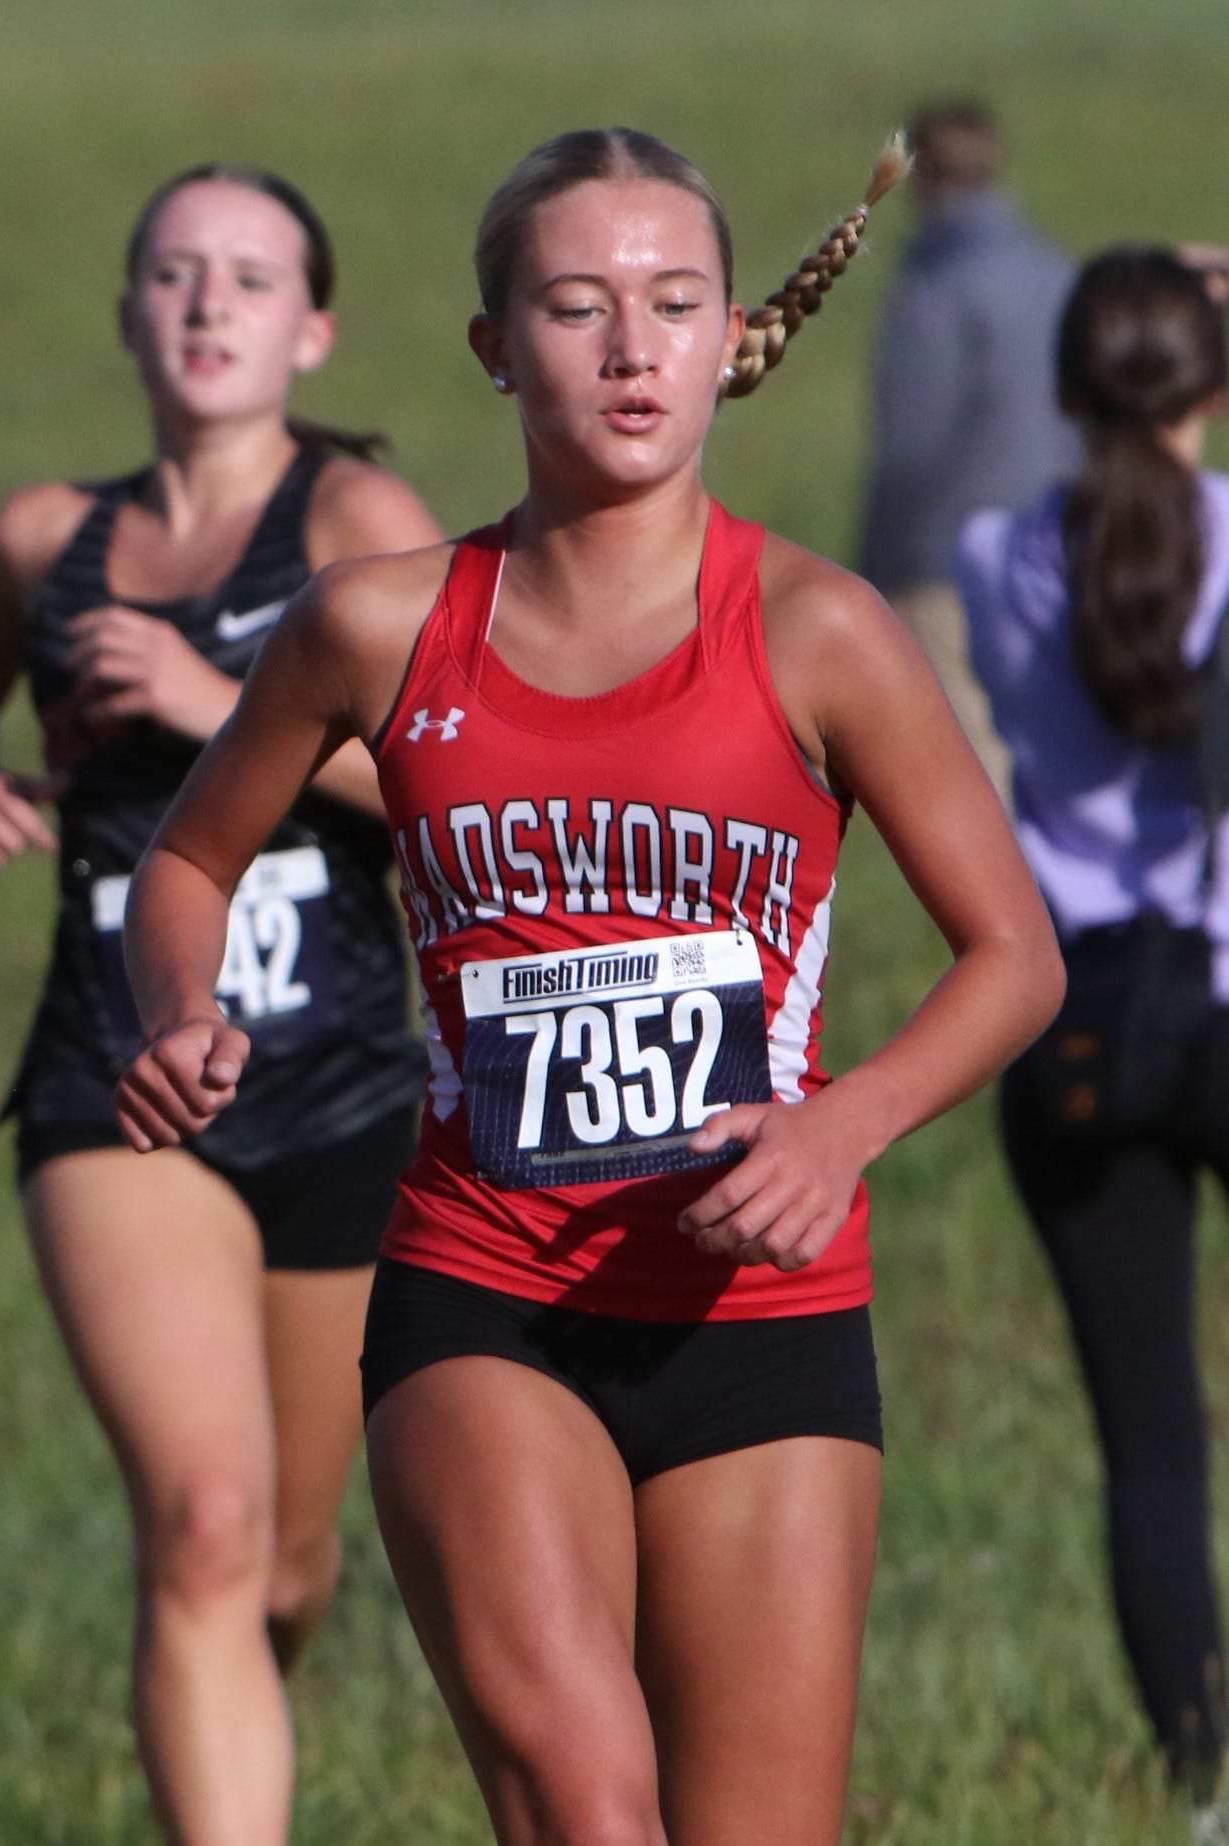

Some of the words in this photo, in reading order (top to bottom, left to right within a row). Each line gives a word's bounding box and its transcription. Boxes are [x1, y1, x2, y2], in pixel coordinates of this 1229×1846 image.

[215, 896, 312, 1019] 42
[502, 950, 660, 1004] FinishTiming
[505, 989, 732, 1149] 7352
